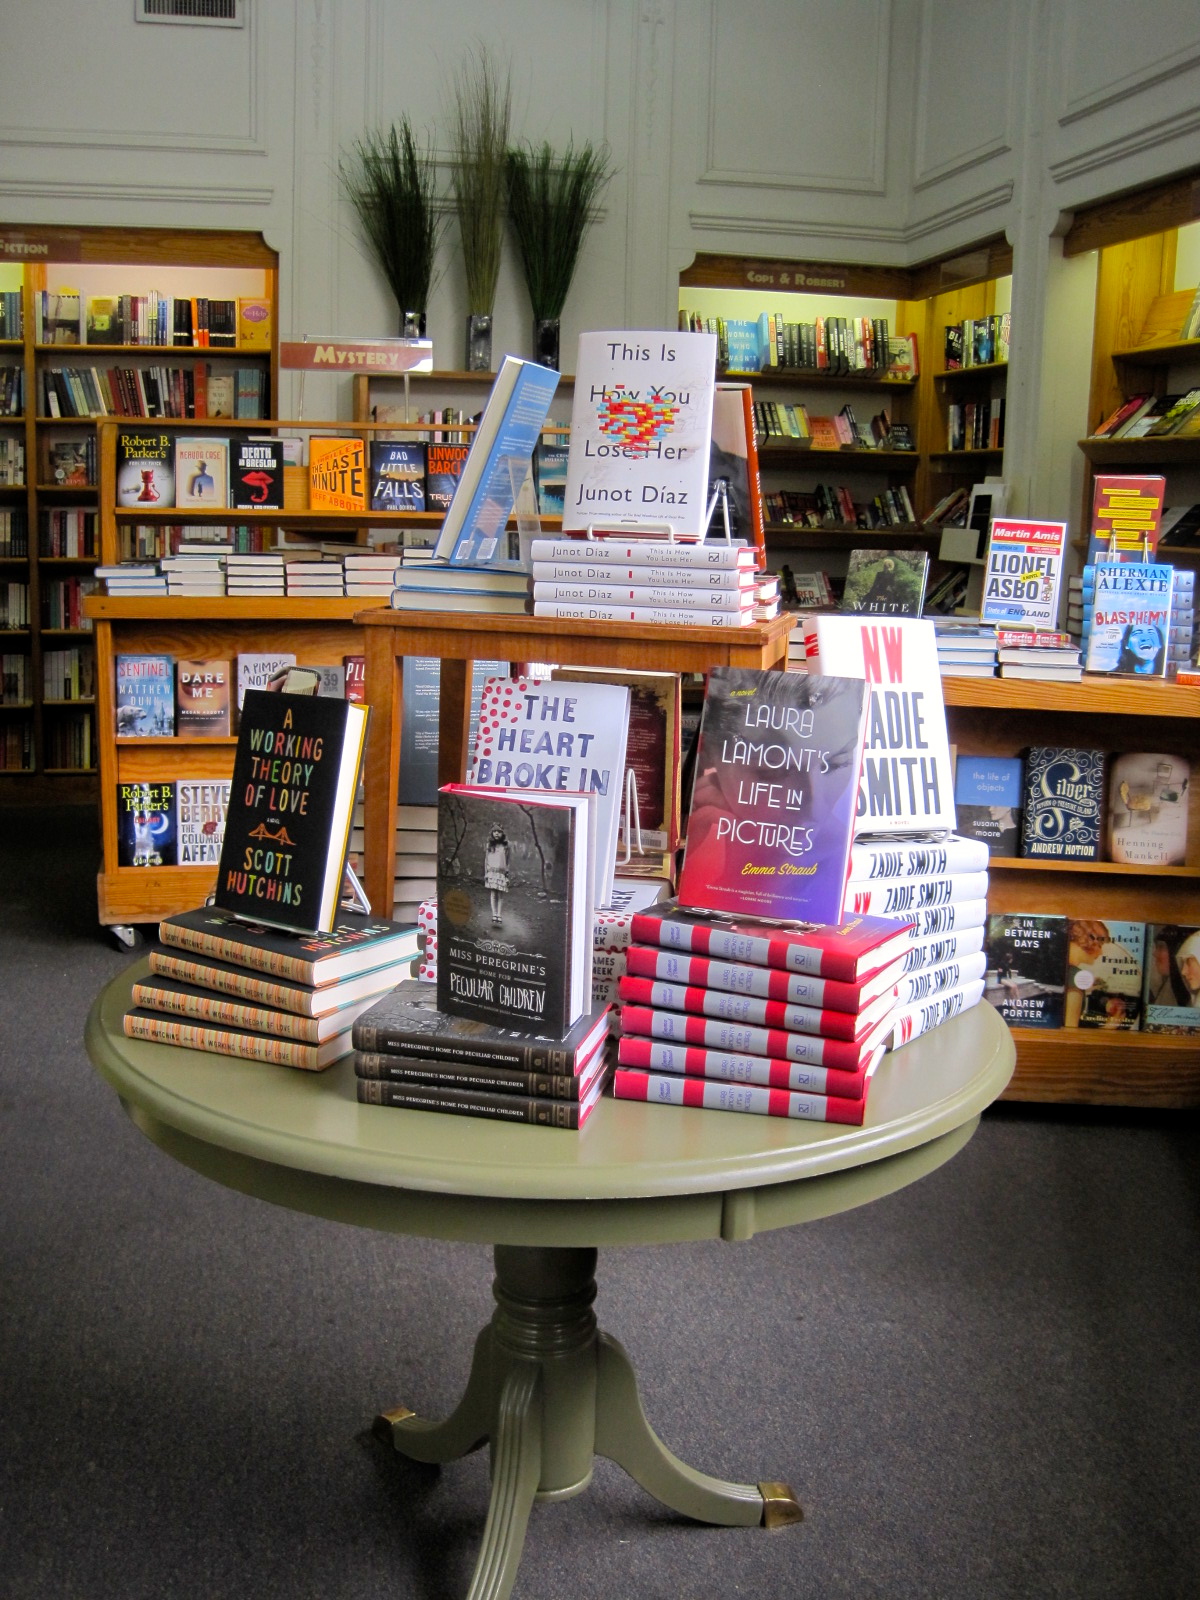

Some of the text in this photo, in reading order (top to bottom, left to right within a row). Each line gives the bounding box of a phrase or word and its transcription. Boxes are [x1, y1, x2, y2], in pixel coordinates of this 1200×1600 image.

[746, 270, 846, 288] COPS & ROBBERS
[313, 346, 399, 366] MYSTERY
[607, 344, 676, 362] This Is
[590, 385, 690, 405] How You
[121, 436, 171, 447] Robert B.
[124, 448, 166, 458] Parker's
[206, 452, 220, 460] CASE
[242, 447, 271, 458] DEATH
[390, 451, 408, 460] BAD
[428, 448, 468, 460] LINWOO
[584, 440, 688, 461] Lose Her
[246, 458, 276, 468] BRESLAU
[312, 450, 363, 474] THE LAST
[380, 464, 418, 472] LITTLE
[312, 468, 364, 496] MINUTE
[374, 482, 424, 498] FALLS
[576, 484, 688, 506] Junot Díaz
[312, 492, 365, 512] JEFF ABBOTT
[994, 528, 1060, 540] Martin Amis
[552, 546, 610, 558] Junot Díaz
[990, 554, 1055, 577] LIONEL
[553, 568, 610, 578] Junot Díaz
[1100, 567, 1168, 578] SHERMAN
[987, 578, 1039, 600] ASBO
[1098, 578, 1168, 592] ALEXIE
[554, 588, 612, 598] Junot Díaz
[797, 590, 814, 598] RED
[800, 597, 820, 605] MIST
[852, 602, 910, 612] WHITE
[556, 608, 613, 620] Junot Díaz
[987, 606, 1050, 618] State ENGLAND
[1096, 610, 1168, 626] BLASPHEMY
[860, 626, 902, 684] NW
[120, 663, 170, 676] SENTINEL
[243, 665, 250, 674] A
[182, 672, 224, 683] DARE
[324, 674, 338, 686] 39
[120, 684, 170, 694] MATTHEW
[192, 688, 214, 698] ME
[737, 688, 756, 696] novel
[524, 694, 578, 722] THE
[283, 708, 294, 730] A
[744, 704, 815, 738] LAURA
[864, 690, 928, 750] ADIE
[250, 728, 324, 762] WORKING
[498, 728, 594, 758] HEART
[722, 740, 830, 774] LAMONT'S
[252, 756, 314, 786] THEORY
[478, 759, 610, 796] BROKE IN
[972, 772, 1010, 781] the life of
[122, 786, 174, 798] Robert B.
[856, 757, 942, 817] SMITH
[976, 782, 1004, 792] objects
[180, 786, 230, 804] STEVE
[245, 784, 310, 816] OF LOVE
[738, 781, 803, 808] LIFE IN
[126, 799, 168, 812] Parker's
[182, 824, 194, 832] THE
[976, 829, 1000, 838] moore
[716, 817, 814, 857] PICTURES
[1031, 842, 1094, 856] ANDREW MOTION
[1117, 838, 1164, 850] Henning
[1125, 850, 1168, 860] Mankell
[243, 848, 292, 876] SCOTT
[869, 849, 947, 879] ZADIE SMITH
[742, 862, 818, 876] Emma Straub
[226, 870, 302, 906] HUTCHINS
[854, 880, 952, 914] NW ZADIE SMITH
[923, 906, 954, 936] SMITH
[1023, 920, 1034, 928] IN
[166, 933, 178, 944] SCOTT
[1004, 929, 1051, 939] BETWEEN
[1014, 939, 1040, 948] DAYS
[930, 938, 956, 968] SMITH
[249, 956, 268, 968] THEORY
[450, 948, 546, 976] MISS PEREGRINE'S
[1102, 956, 1138, 966] Frankie
[156, 963, 168, 974] SCOTT
[480, 969, 511, 980] HOME FOR
[908, 963, 960, 1004] ZADIE SMITH
[245, 986, 264, 1000] THEORY
[450, 972, 546, 1013] PECULIAR CHILDREN
[139, 995, 154, 1005] SCOTT
[1002, 999, 1044, 1008] ANDREW
[900, 992, 964, 1046] NW ZADIE SMITH
[1002, 1008, 1042, 1018] PORTER
[242, 1014, 264, 1028] THEORY
[131, 1026, 148, 1036] SCOTT
[238, 1042, 262, 1054] THEORY
[400, 1042, 520, 1062] PEREGRINE'S HOME PECULIAR CHILDREN
[404, 1069, 438, 1079] PEREGRINE'S
[469, 1077, 495, 1085] PECULIAR
[496, 1080, 524, 1088] CHILDREN
[406, 1096, 524, 1116] PEREGRINE'S HOME PECULIAR CHILDREN
